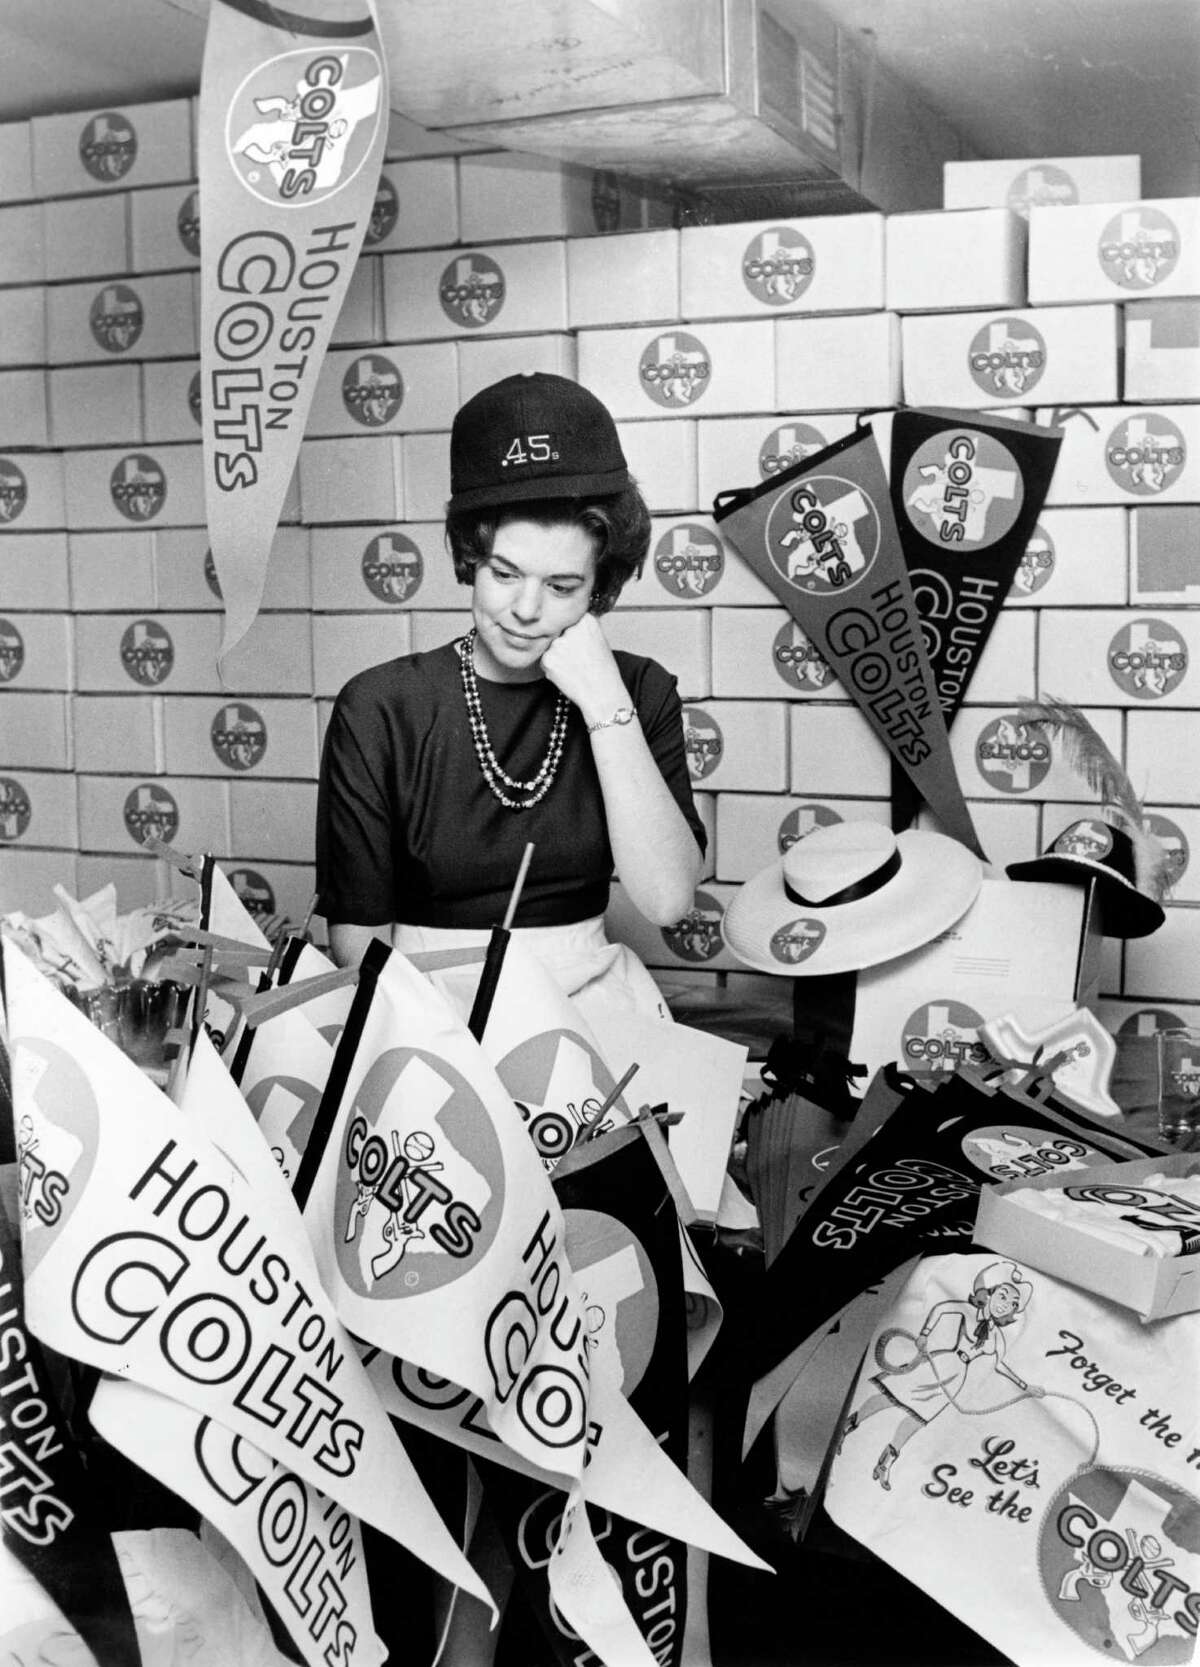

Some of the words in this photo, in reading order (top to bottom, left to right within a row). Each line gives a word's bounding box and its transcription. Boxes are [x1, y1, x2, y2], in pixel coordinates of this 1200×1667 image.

[279, 55, 343, 199] COLTS
[745, 258, 814, 278] COLTS
[211, 230, 296, 492] COLTS
[264, 221, 357, 430] HOUSTON
[642, 362, 709, 381] COLTS
[971, 350, 1044, 371] COLTS
[940, 436, 976, 543] COLTS
[1109, 447, 1185, 466] COLTS
[656, 555, 722, 573] COLTS
[791, 488, 852, 587] COLTS
[825, 607, 931, 767] COLTS
[871, 580, 932, 720] HOUSTON
[1111, 652, 1186, 671] COLTS
[905, 1038, 990, 1063] COLTS
[345, 1116, 482, 1259] COLTS
[128, 1138, 345, 1382] HOUSTON
[71, 1231, 365, 1477] COLTS
[1045, 1331, 1137, 1405] Forget
[1139, 1408, 1182, 1448] the
[921, 1463, 975, 1508] See
[987, 1489, 1033, 1524] the
[970, 1435, 1040, 1490] Let's
